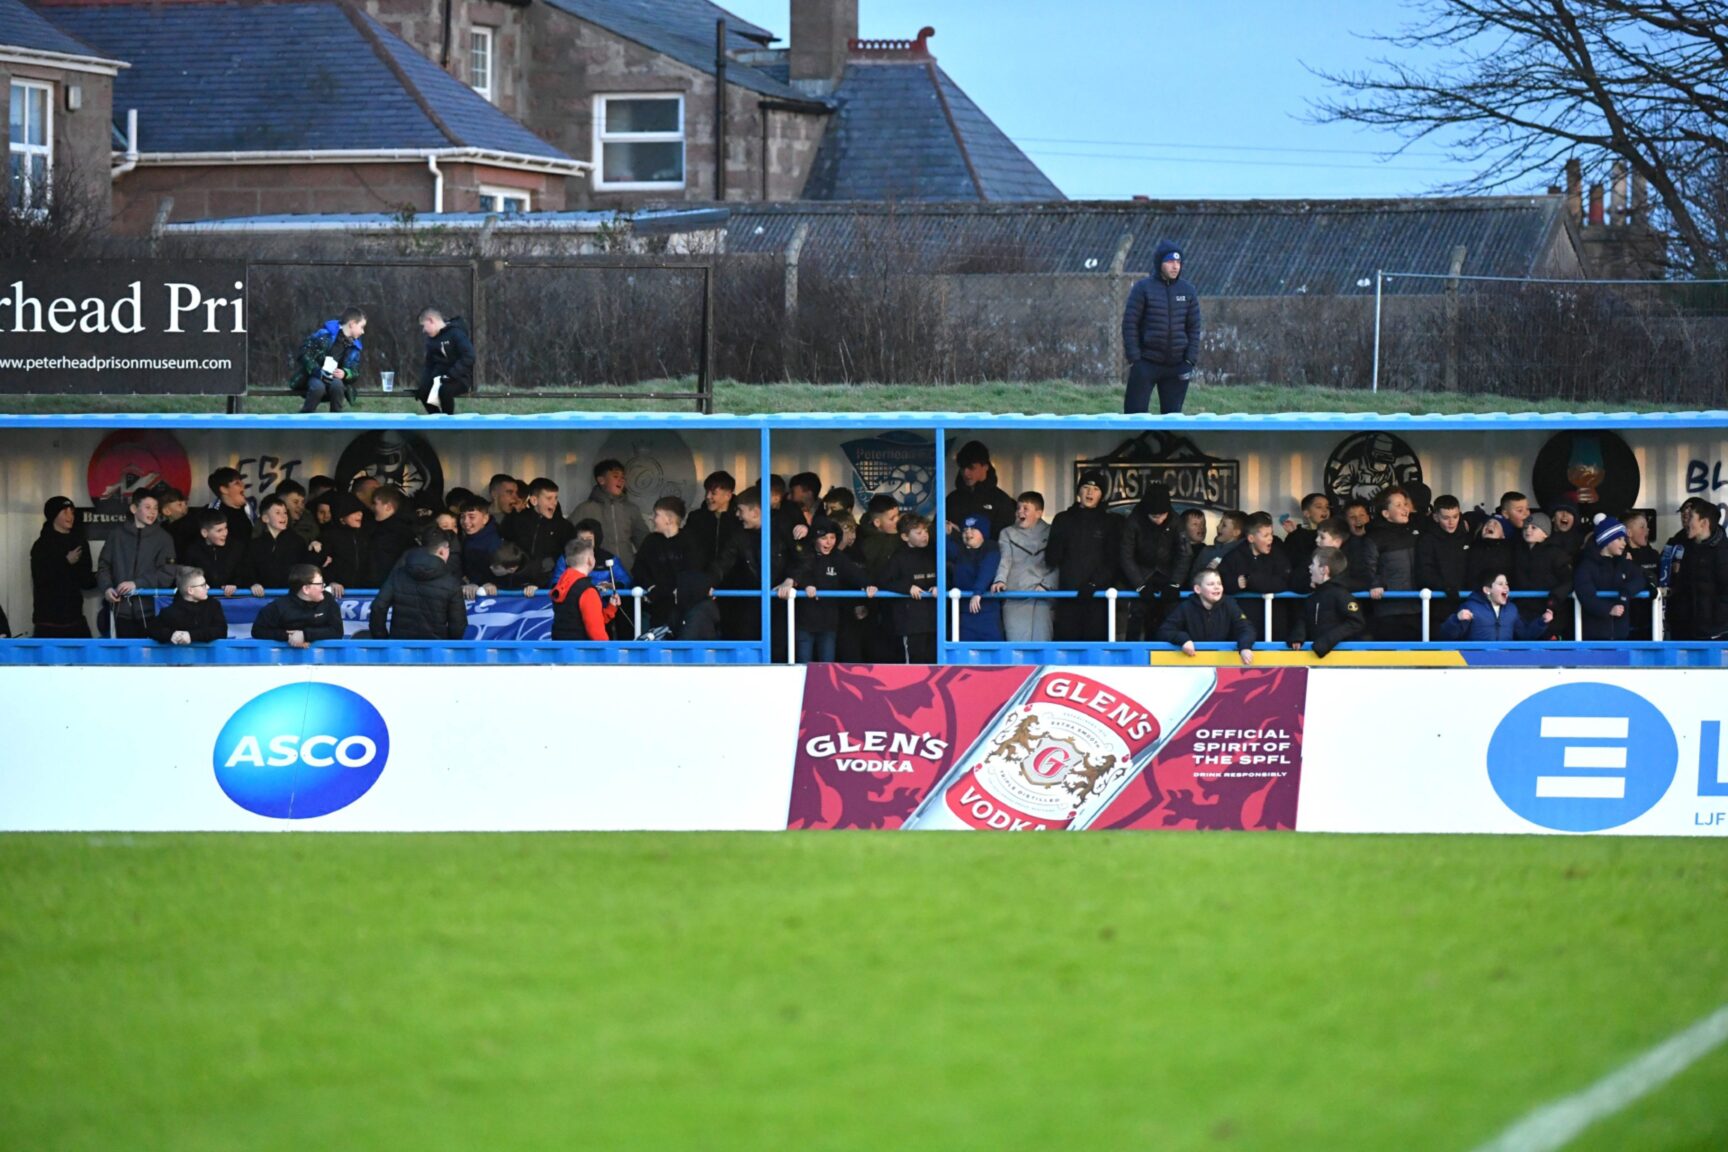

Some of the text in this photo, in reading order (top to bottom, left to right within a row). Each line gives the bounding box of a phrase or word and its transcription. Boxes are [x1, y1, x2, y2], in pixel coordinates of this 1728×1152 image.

[164, 281, 247, 333] Pri
[1085, 468, 1150, 501] OAST
[83, 512, 127, 523] Bruce
[1046, 678, 1152, 740] GLEN'S
[1195, 729, 1290, 739] OFFICIAL
[224, 735, 377, 768] ASCO
[806, 731, 949, 760] GLEN'S
[1193, 742, 1291, 752] SPIRIT OF
[835, 759, 914, 772] VODKA
[1033, 747, 1070, 777] G
[1192, 755, 1291, 765] THE SPFL
[1694, 812, 1726, 826] LJF
